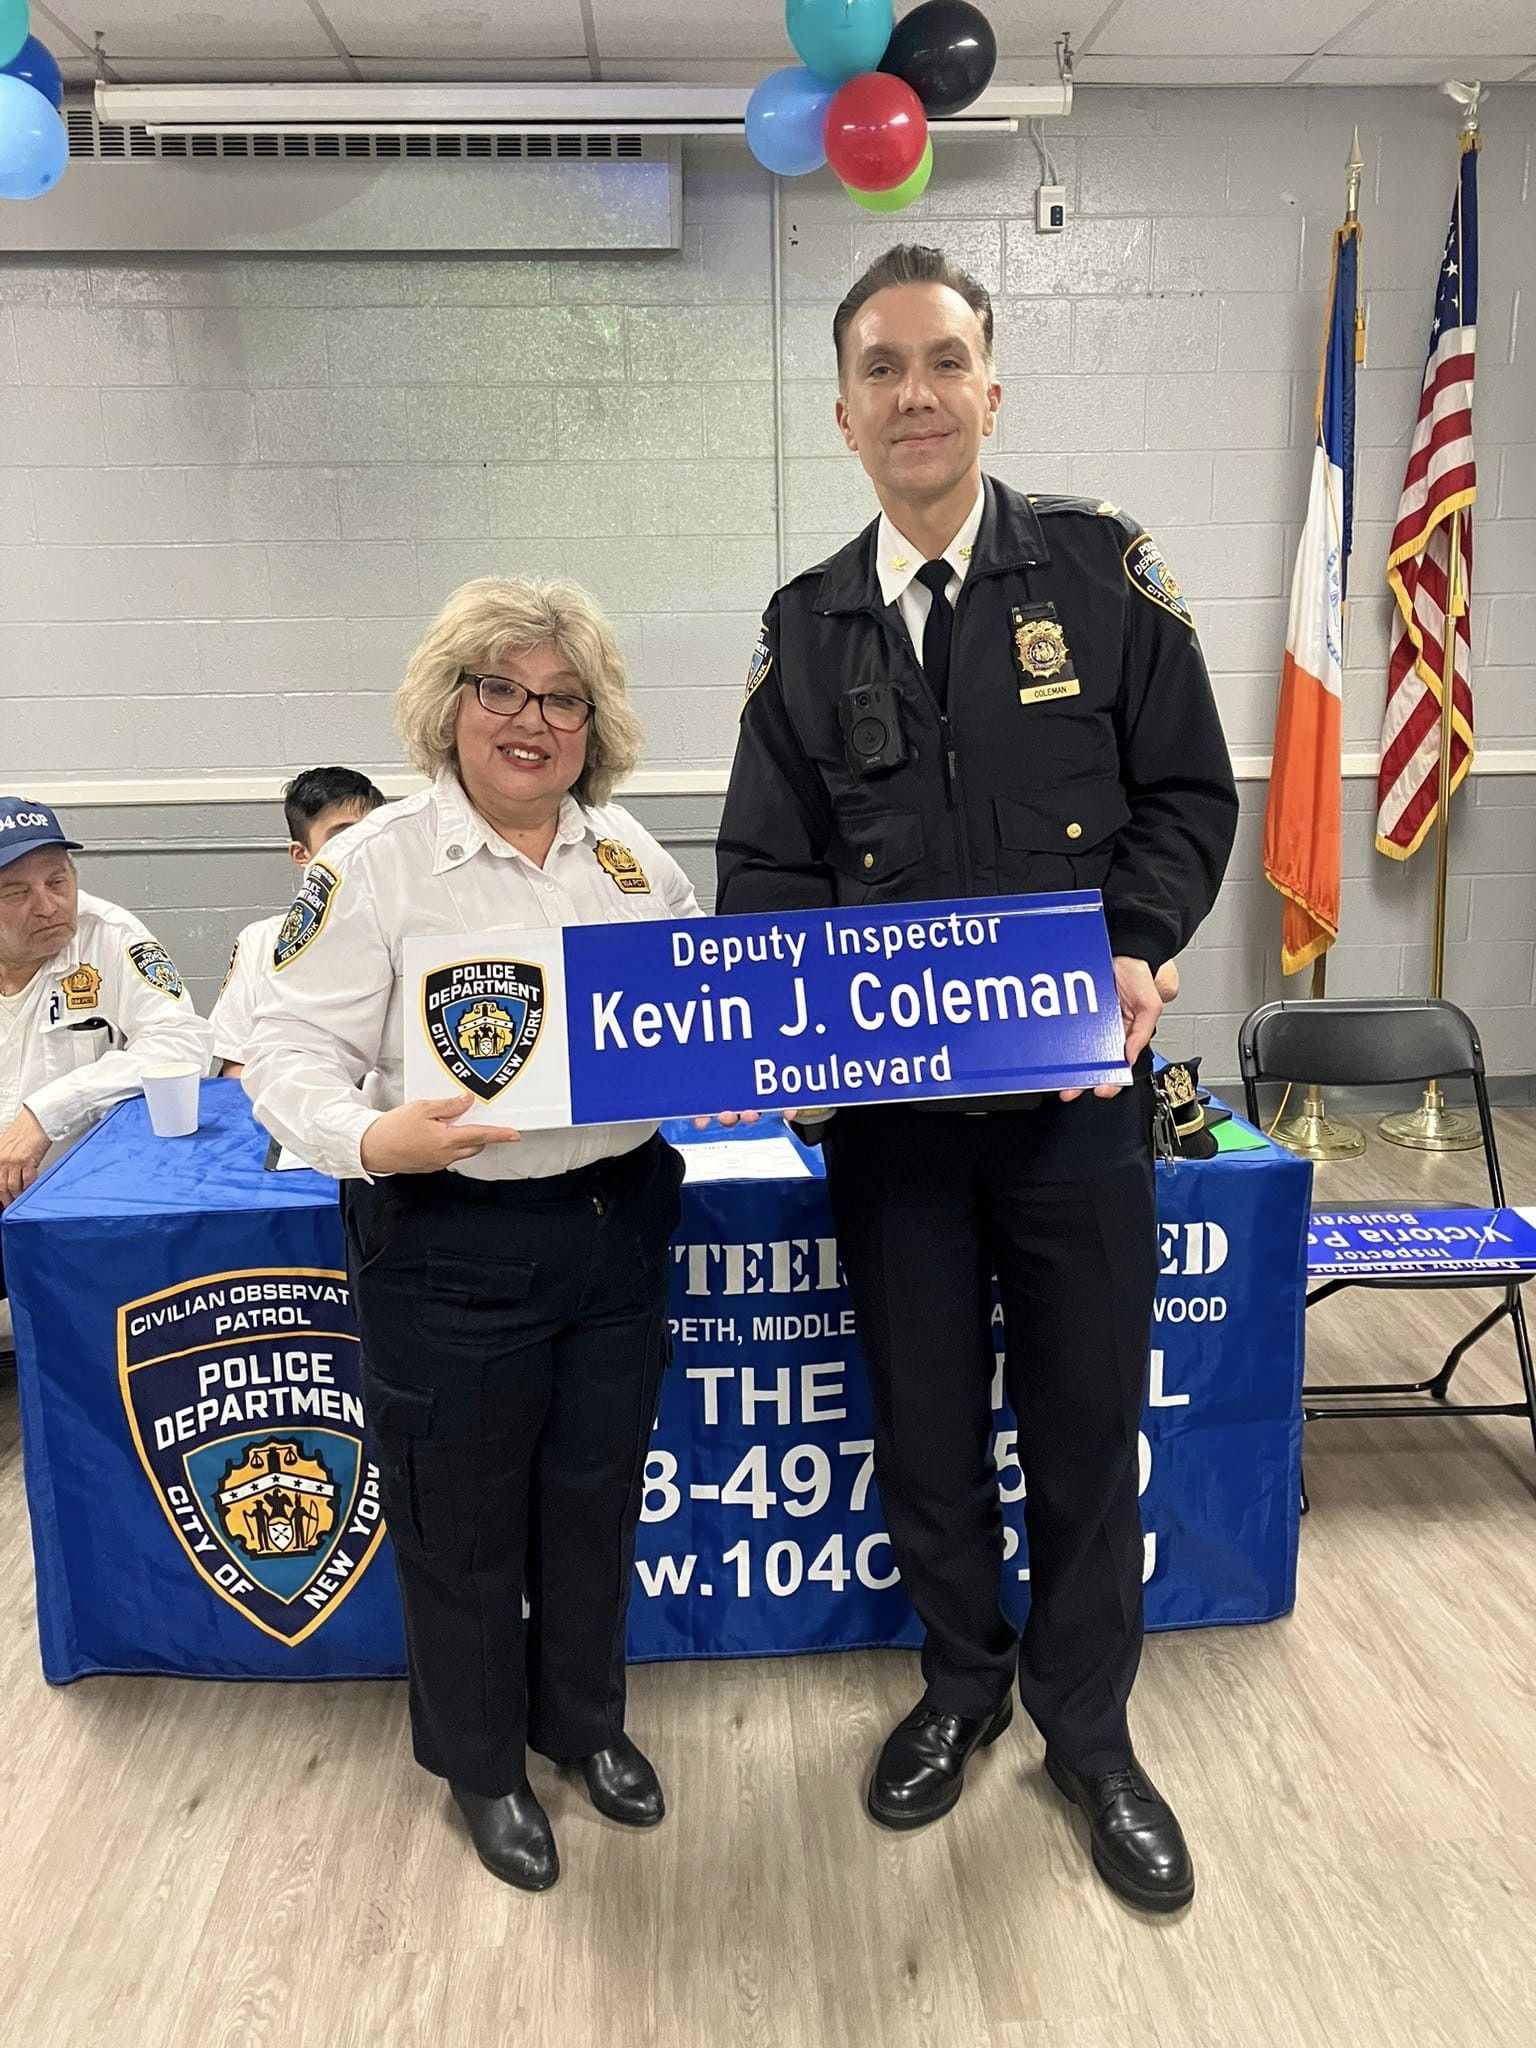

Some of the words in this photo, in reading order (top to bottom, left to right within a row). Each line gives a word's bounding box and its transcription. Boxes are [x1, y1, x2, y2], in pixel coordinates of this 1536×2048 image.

[1147, 584, 1169, 602] CITY
[1034, 685, 1067, 698] COLEMAN
[16, 813, 48, 827] COP
[299, 922, 319, 945] YORK
[671, 925, 807, 972] Deputy
[824, 912, 1001, 960] Inspector
[453, 964, 516, 984] POLICE
[429, 980, 540, 1011] DEPARTMENT
[592, 983, 753, 1051] Kevin
[779, 977, 827, 1037] J.
[850, 967, 1099, 1031] Coleman
[432, 1022, 455, 1057] CITY
[451, 1061, 471, 1080] OF
[495, 1053, 523, 1086] NEW
[520, 1008, 542, 1047] YORK
[754, 1045, 952, 1096] Boulevard
[1309, 1213, 1419, 1226] Boulevar
[1358, 1226, 1514, 1247] Victoria
[1334, 1247, 1452, 1262] Inspector
[130, 1290, 227, 1336] CIVILIAN
[215, 1307, 311, 1336] PATROL
[752, 1310, 856, 1341] MIDDLE
[198, 1351, 335, 1398] POLICE
[686, 1361, 847, 1426] THE
[166, 1484, 218, 1555] CITY
[214, 1563, 255, 1597] OF
[303, 1549, 356, 1610] NEW
